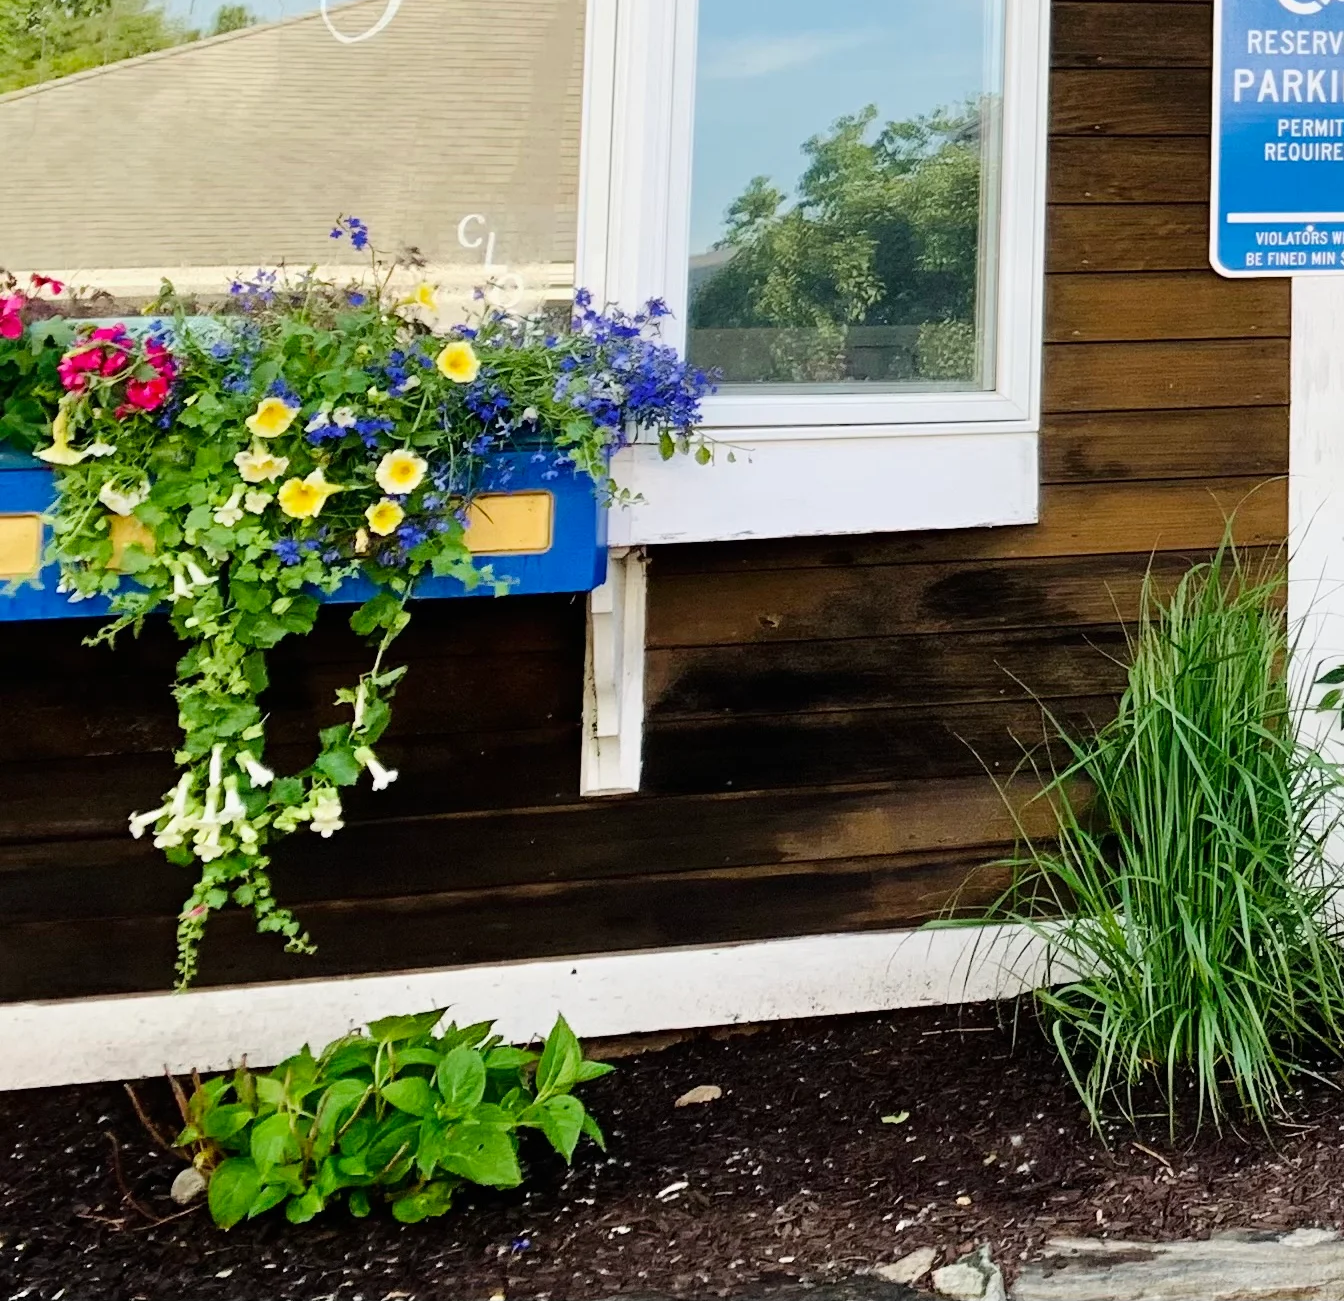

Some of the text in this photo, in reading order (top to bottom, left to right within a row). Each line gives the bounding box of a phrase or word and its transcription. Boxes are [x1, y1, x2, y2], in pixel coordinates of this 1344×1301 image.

[1277, 118, 1344, 138] PERMIT
[1255, 230, 1329, 246] VIOLATORS
[1245, 251, 1265, 266] BE
[1267, 251, 1308, 266] FINED
[1311, 251, 1337, 266] MIN
